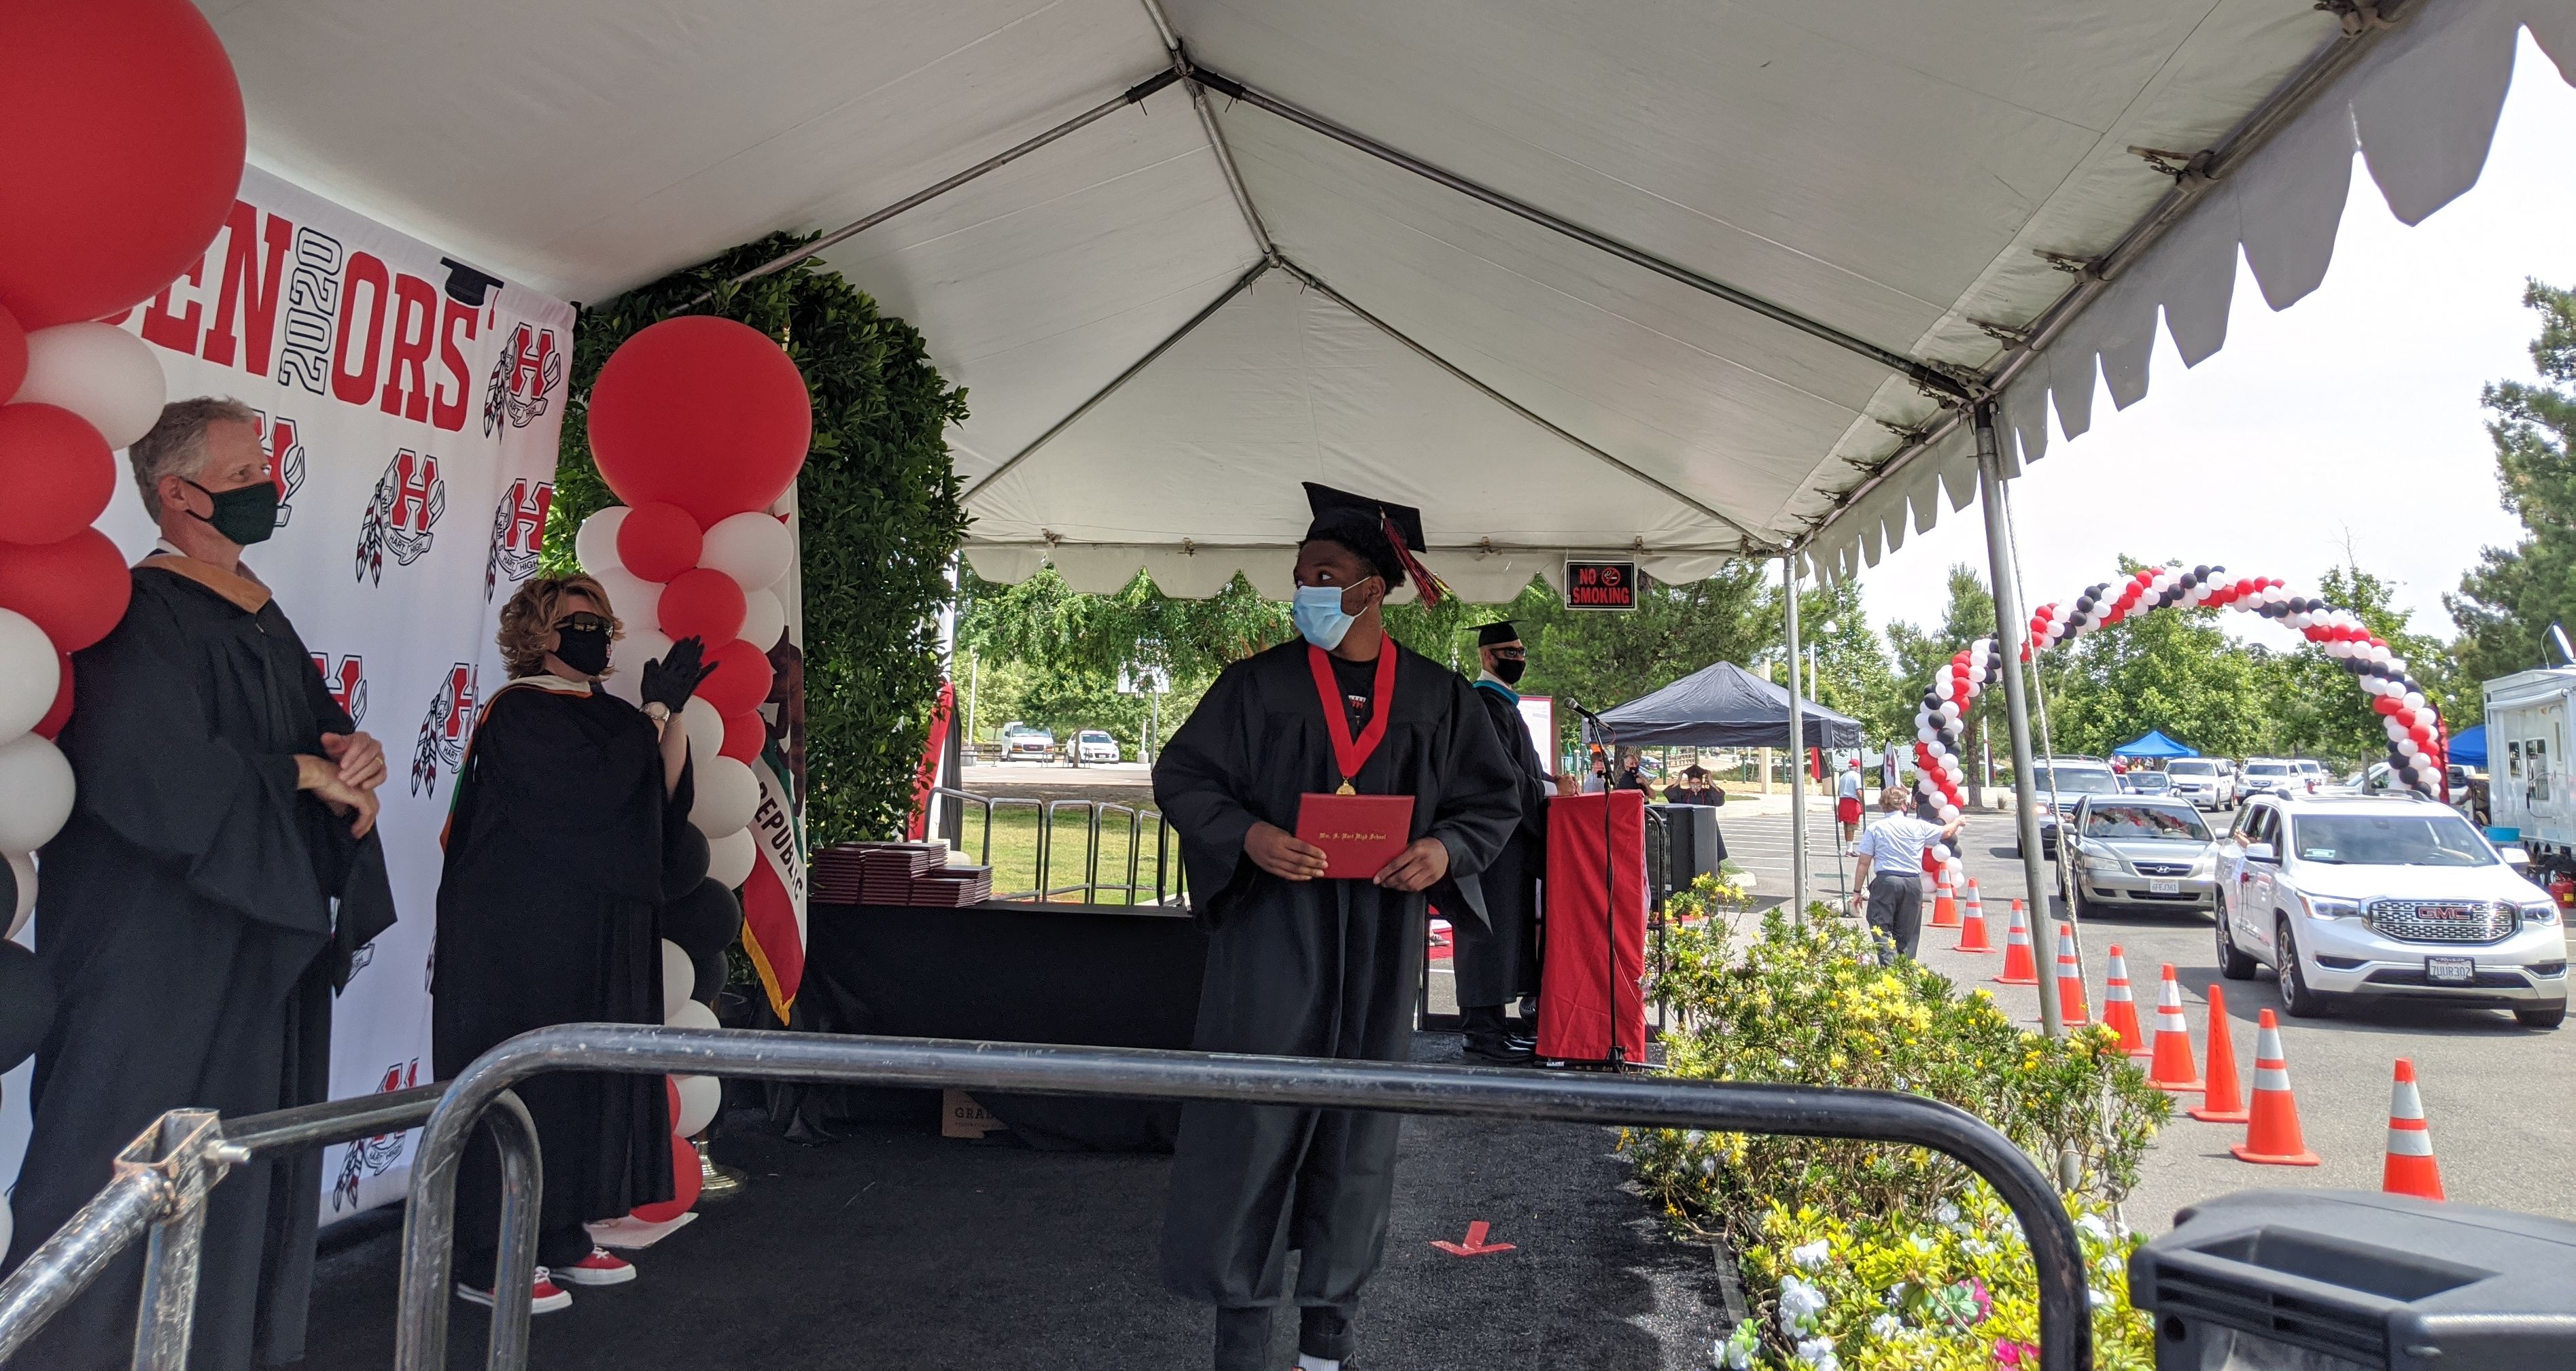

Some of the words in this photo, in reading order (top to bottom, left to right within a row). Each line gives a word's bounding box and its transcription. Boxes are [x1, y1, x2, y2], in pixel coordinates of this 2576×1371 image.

[389, 448, 439, 536] H
[389, 534, 406, 551] HART
[410, 541, 423, 555] HIGH
[502, 555, 515, 568] HART
[520, 559, 539, 571] HIGH
[1579, 568, 1597, 585] NO
[1573, 587, 1629, 604] SMOKING
[443, 746, 457, 761] HART
[2418, 907, 2471, 920] GMC
